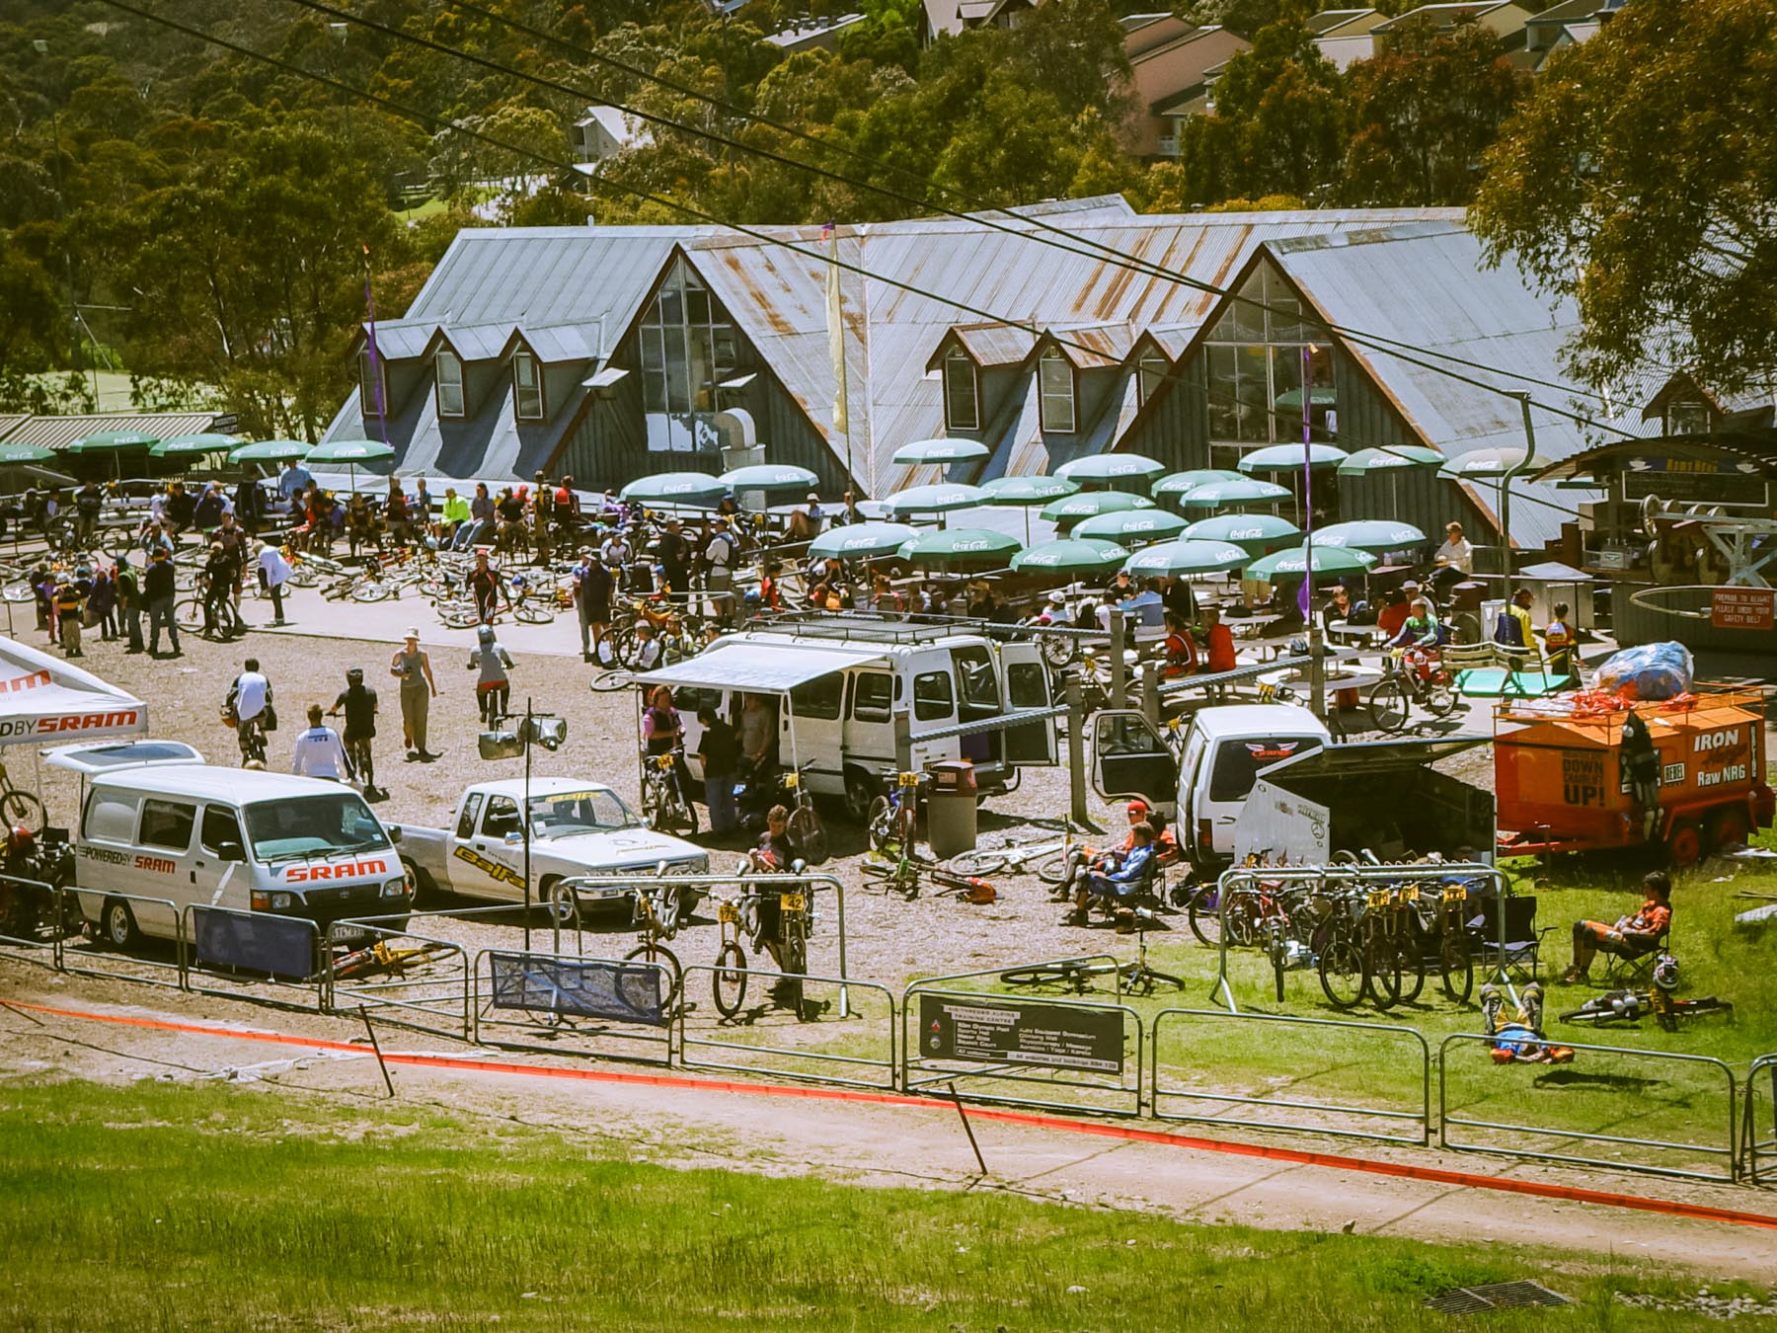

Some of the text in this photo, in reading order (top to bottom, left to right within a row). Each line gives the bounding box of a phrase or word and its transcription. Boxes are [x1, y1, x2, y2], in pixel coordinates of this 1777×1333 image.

[37, 711, 137, 733] SRAM
[1693, 729, 1740, 752] IRON
[1563, 758, 1604, 774] DOWN
[1697, 763, 1747, 787] Raw NRG
[1564, 783, 1605, 806] UP!
[134, 855, 176, 874] SRAM
[286, 859, 387, 883] SRAM
